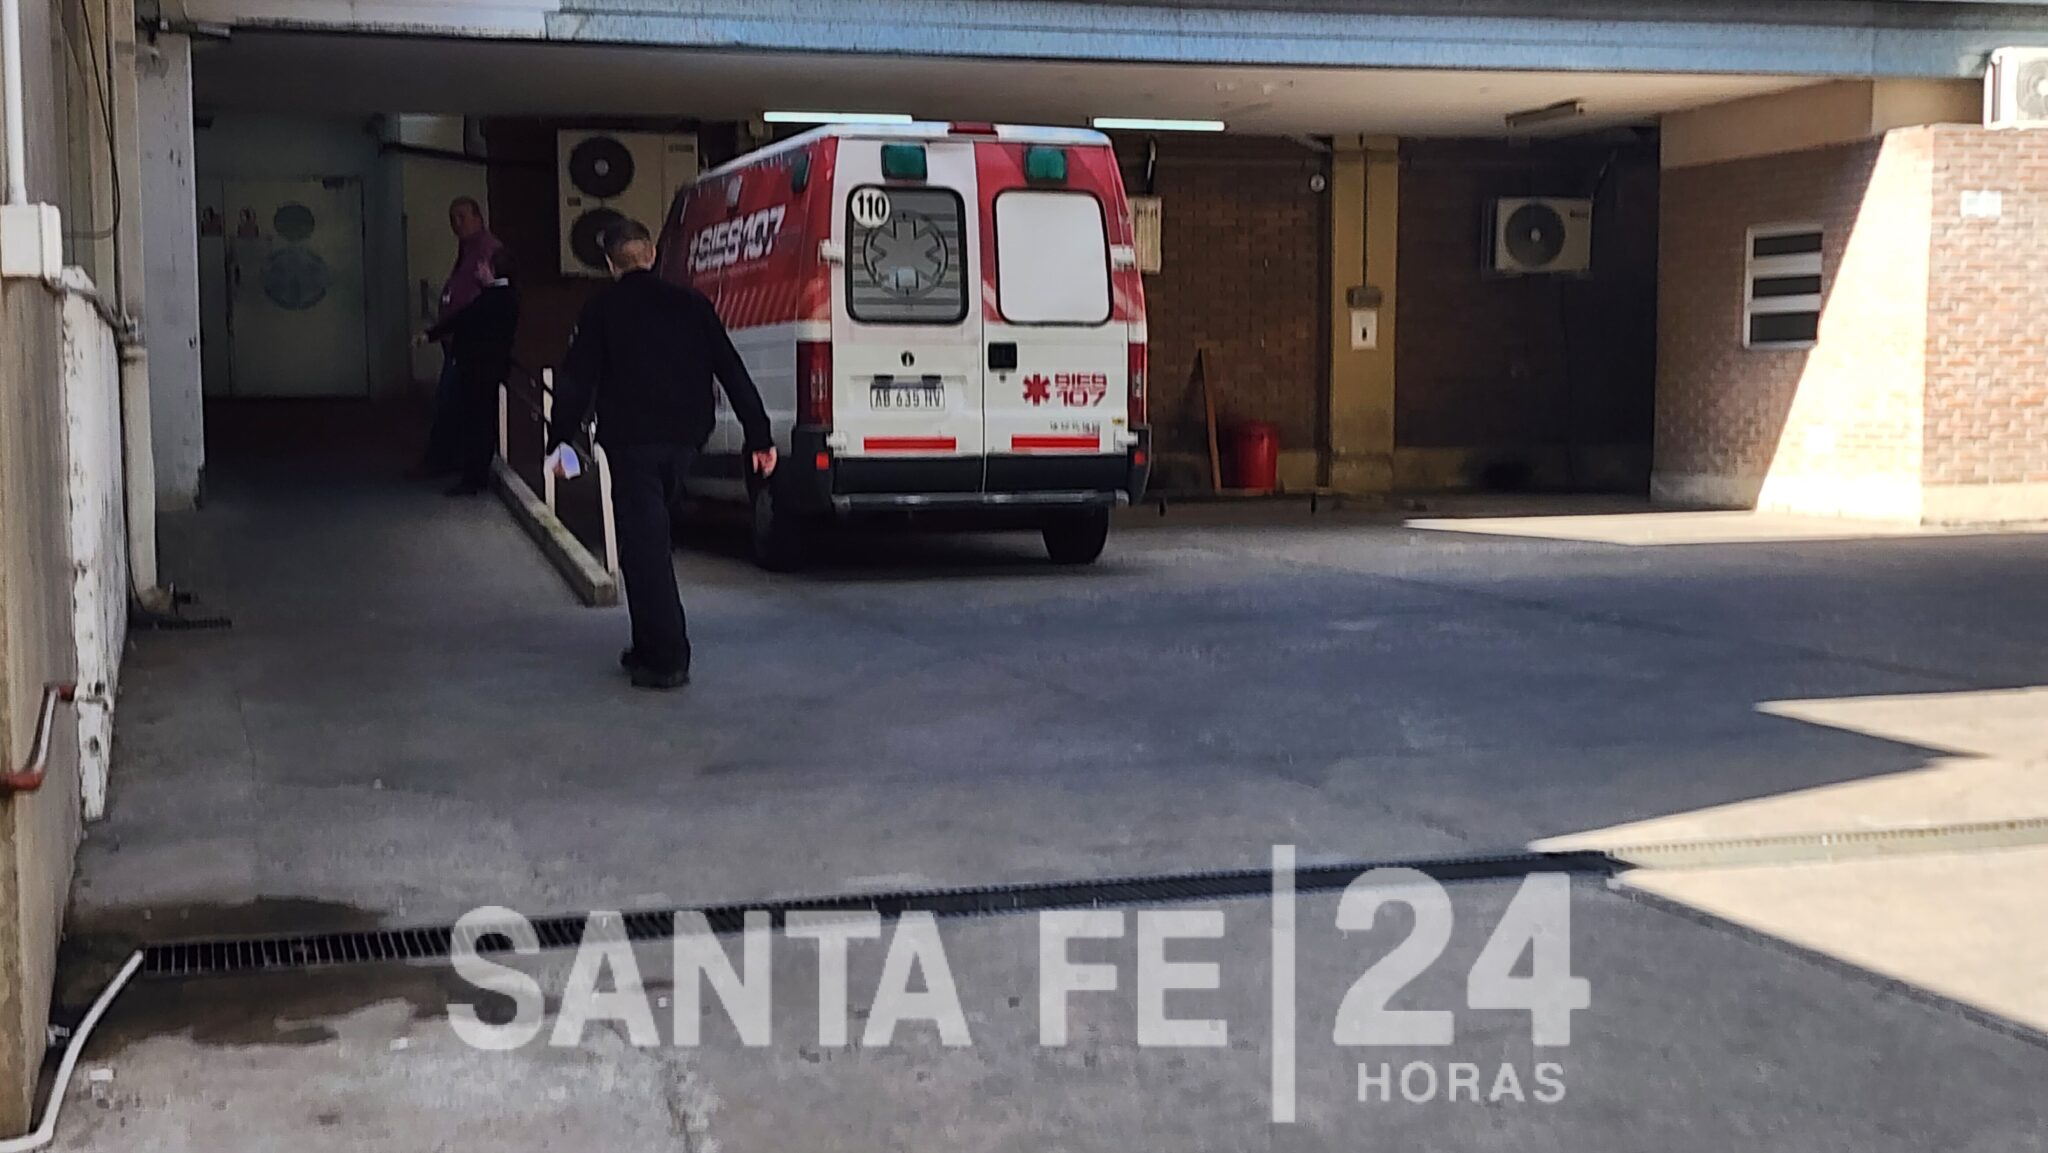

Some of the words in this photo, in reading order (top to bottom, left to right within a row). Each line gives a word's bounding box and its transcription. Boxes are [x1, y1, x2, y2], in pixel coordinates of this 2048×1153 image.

[857, 191, 887, 221] 110
[1054, 373, 1107, 389] SIES
[875, 388, 891, 408] AB
[896, 389, 920, 408] 635
[1056, 390, 1107, 407] 107
